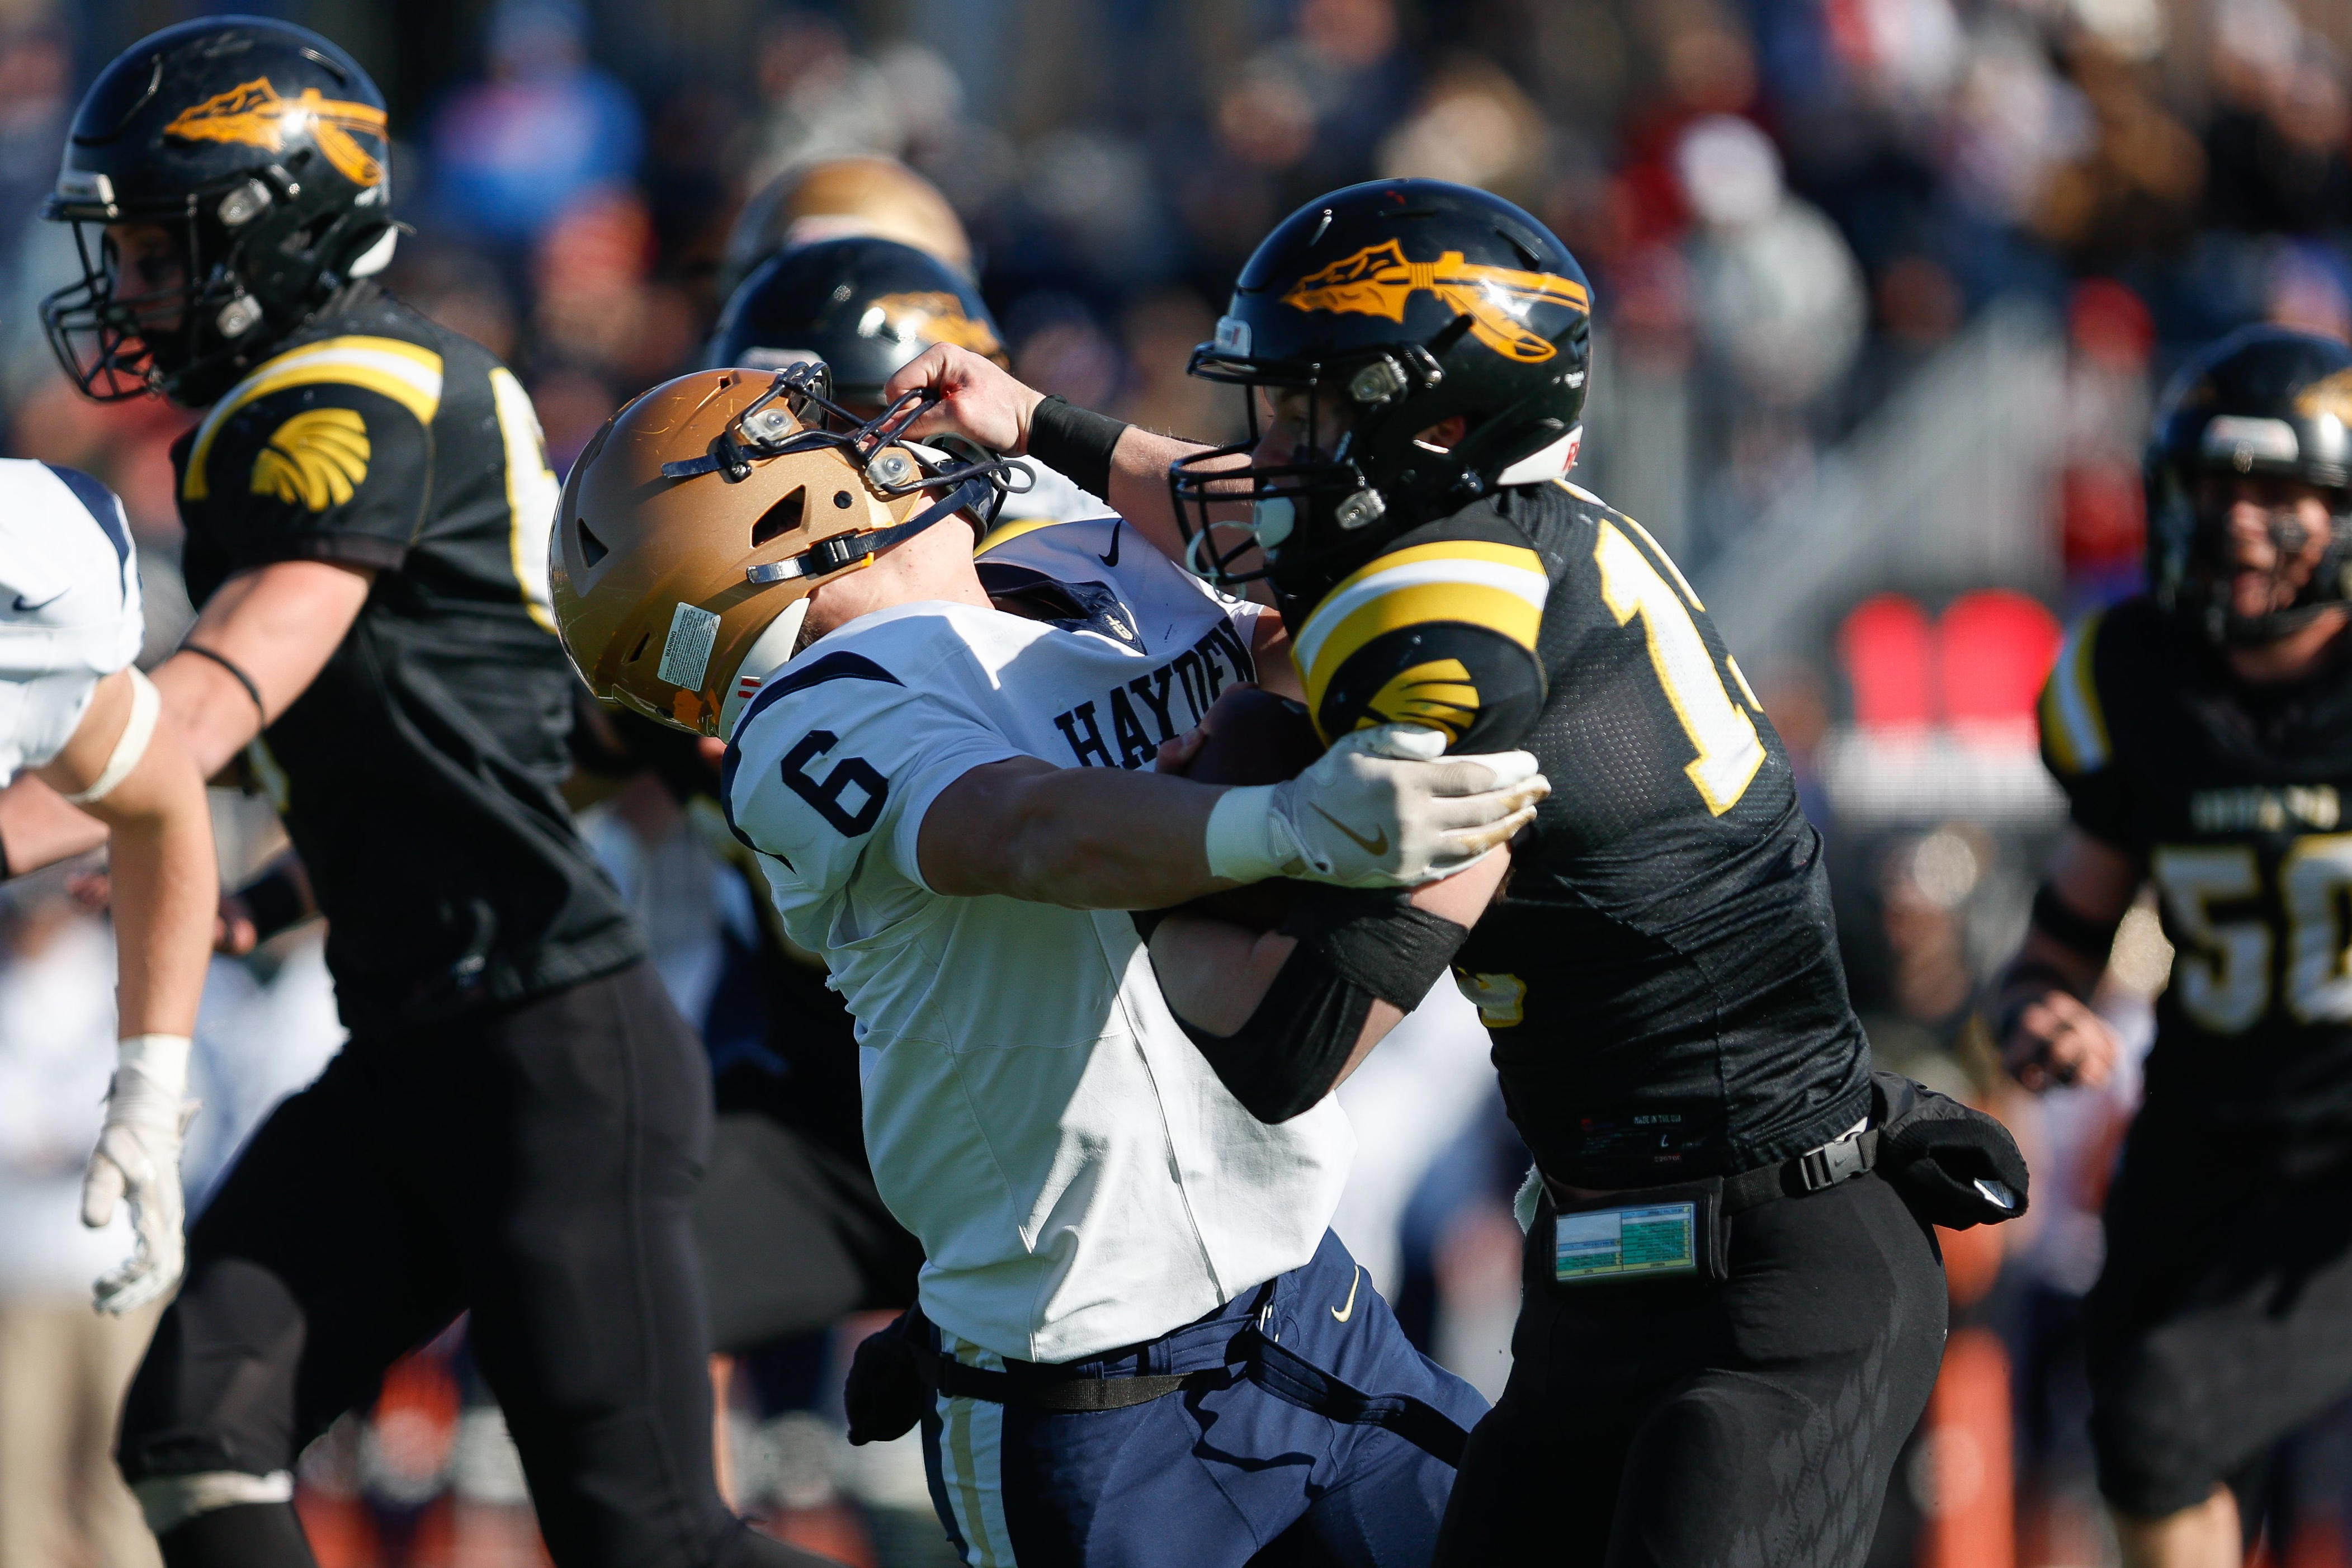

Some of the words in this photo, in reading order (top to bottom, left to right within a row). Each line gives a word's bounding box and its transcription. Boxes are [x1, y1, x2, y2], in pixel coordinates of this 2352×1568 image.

[665, 630, 677, 657] WARNING
[1054, 616, 1258, 769] HAYDEN
[781, 729, 889, 838] 6
